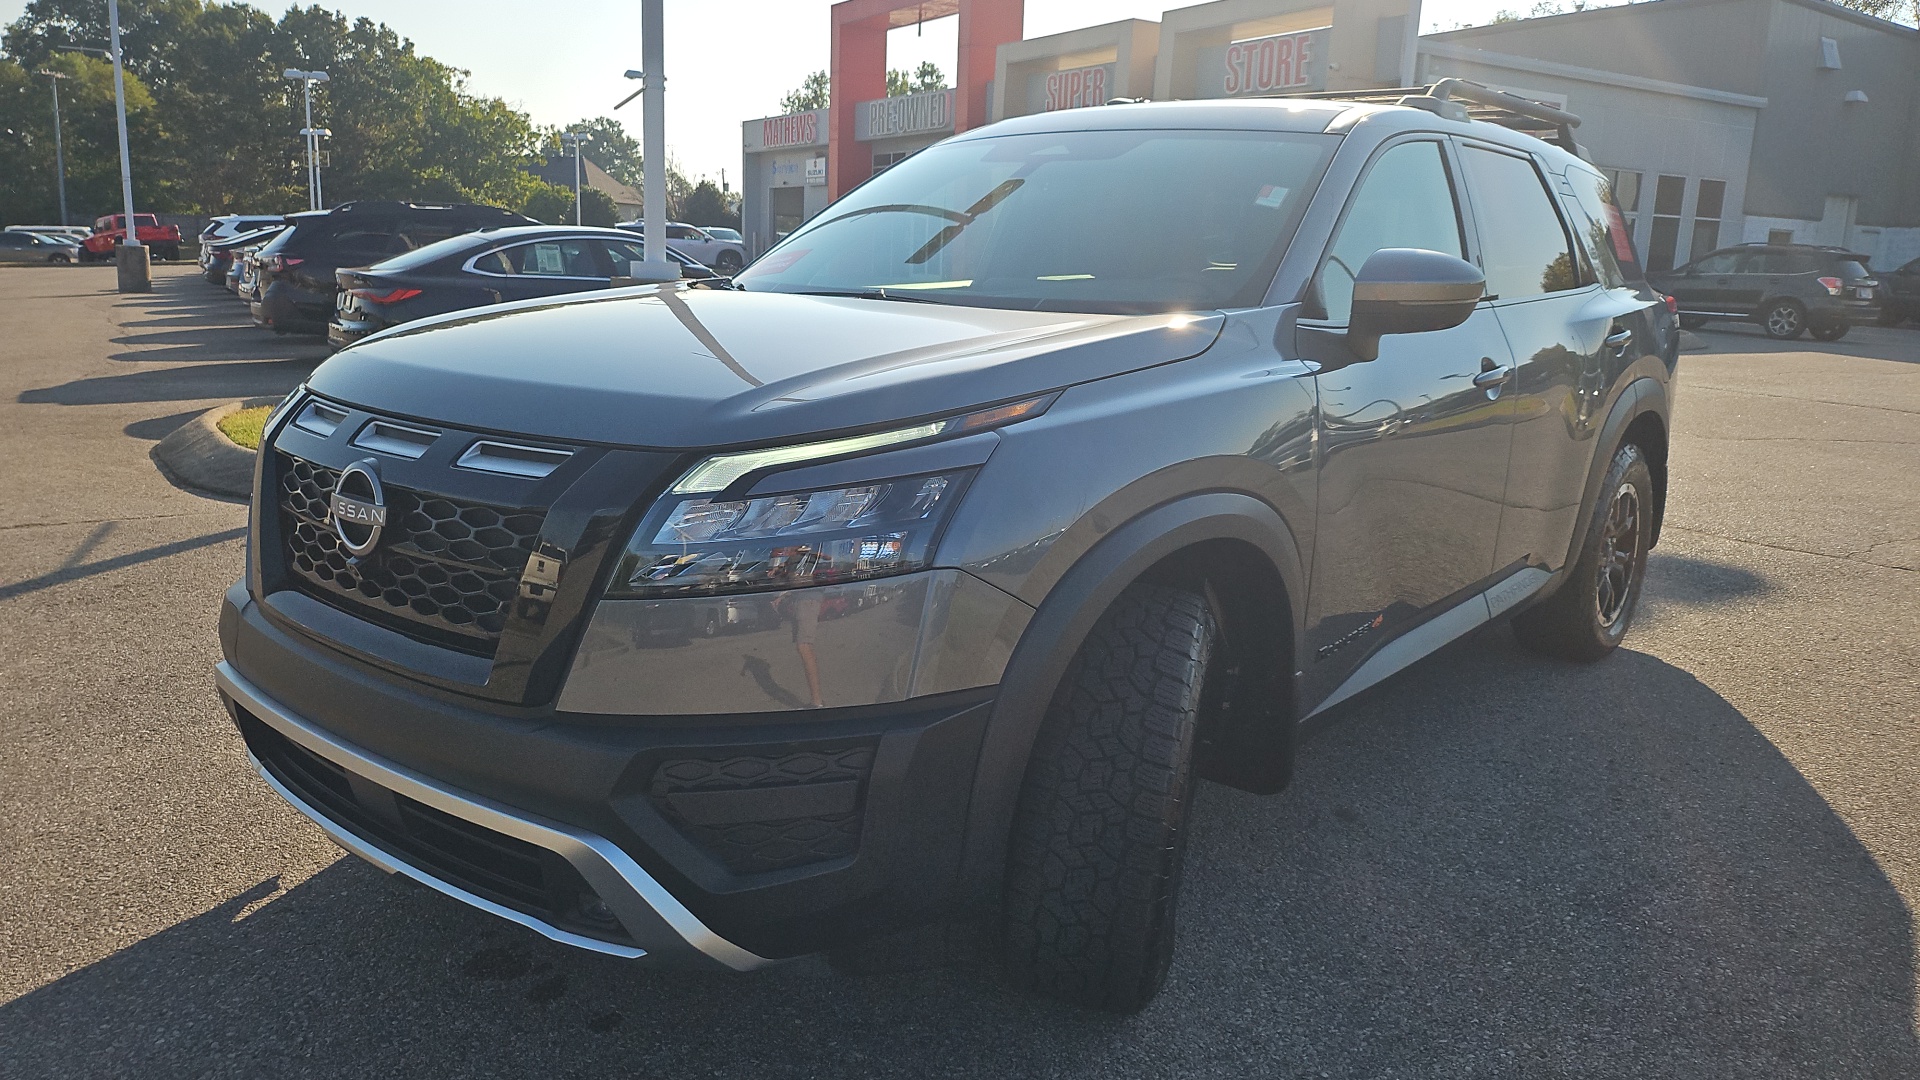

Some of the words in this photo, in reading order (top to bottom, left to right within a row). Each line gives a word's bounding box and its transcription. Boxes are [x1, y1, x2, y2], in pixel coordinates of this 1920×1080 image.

[1225, 34, 1311, 94] STORE
[1046, 67, 1106, 112] SUPER
[763, 113, 815, 148] MATHEWS
[869, 93, 947, 136] PRE-OWNED
[331, 501, 384, 523] SSAN
